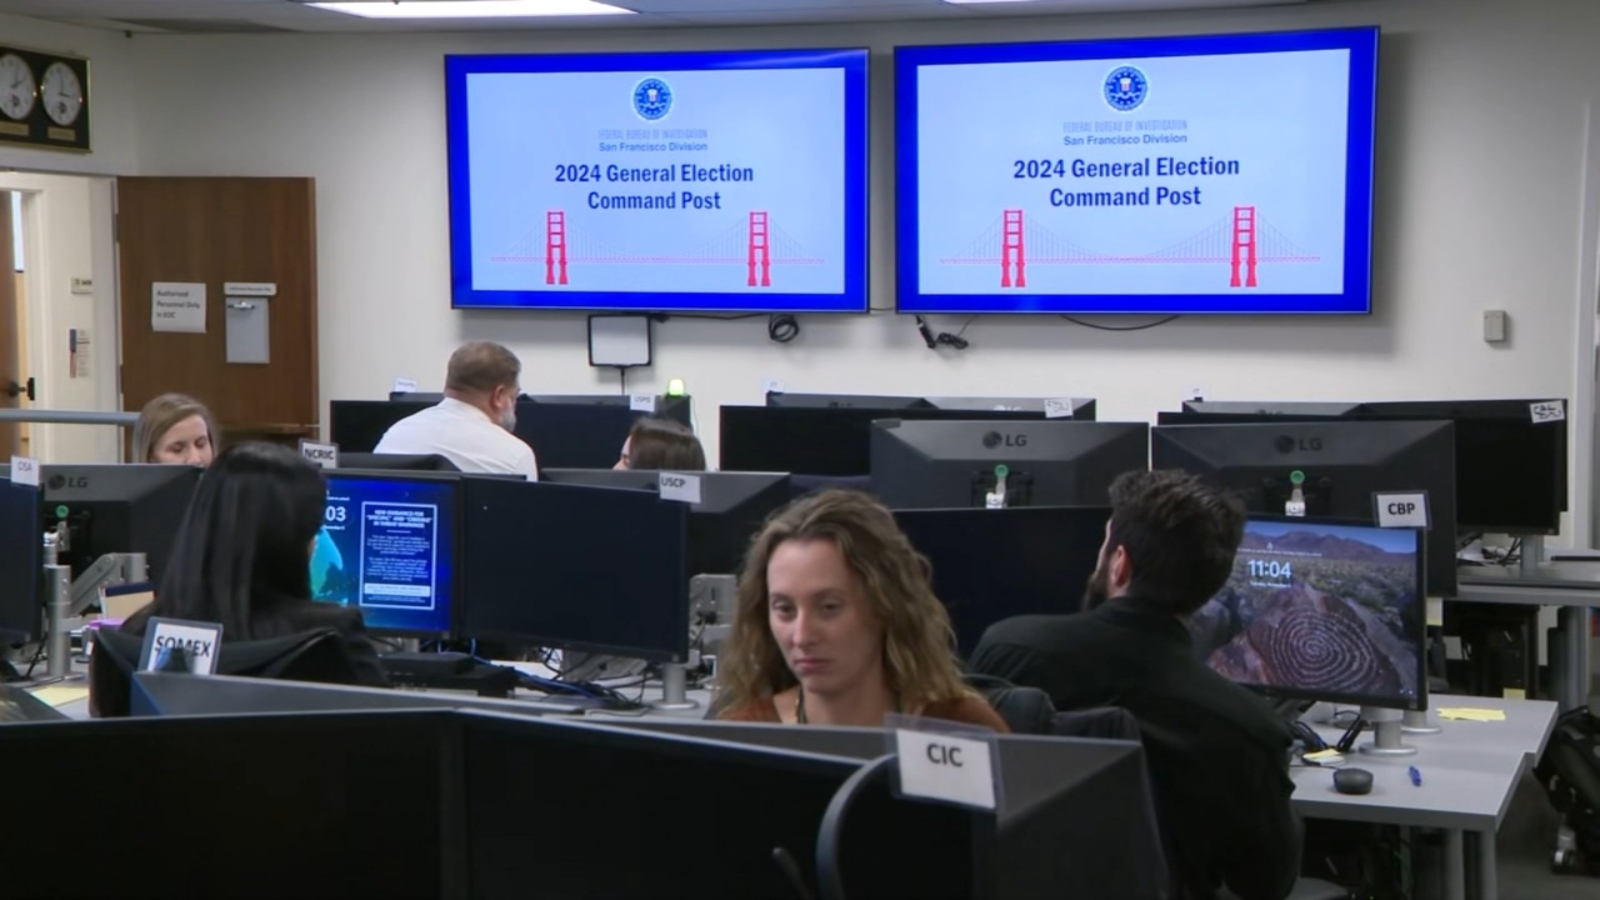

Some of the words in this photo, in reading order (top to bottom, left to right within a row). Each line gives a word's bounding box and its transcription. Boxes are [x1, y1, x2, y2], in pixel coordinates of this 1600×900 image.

[1063, 135, 1085, 146] San
[1087, 134, 1140, 145] Francisco
[1143, 132, 1187, 144] Division
[599, 142, 617, 152] San
[619, 142, 667, 152] Francisco
[669, 141, 707, 151] Division
[554, 163, 602, 183] 2024
[606, 163, 676, 182] General
[681, 162, 754, 182] Election
[1013, 159, 1066, 179] 2024
[1071, 157, 1150, 178] General
[1156, 155, 1240, 176] Election
[587, 190, 676, 210] Command
[681, 190, 722, 210] Post
[1050, 186, 1150, 207] Command
[1156, 185, 1202, 206] Post
[1005, 434, 1027, 447] LG
[1298, 437, 1322, 451] LG
[67, 476, 89, 489] LG
[660, 476, 686, 488] USCP
[1387, 502, 1416, 516] CBP
[1247, 558, 1293, 580] 11:04
[926, 743, 963, 767] CIC
